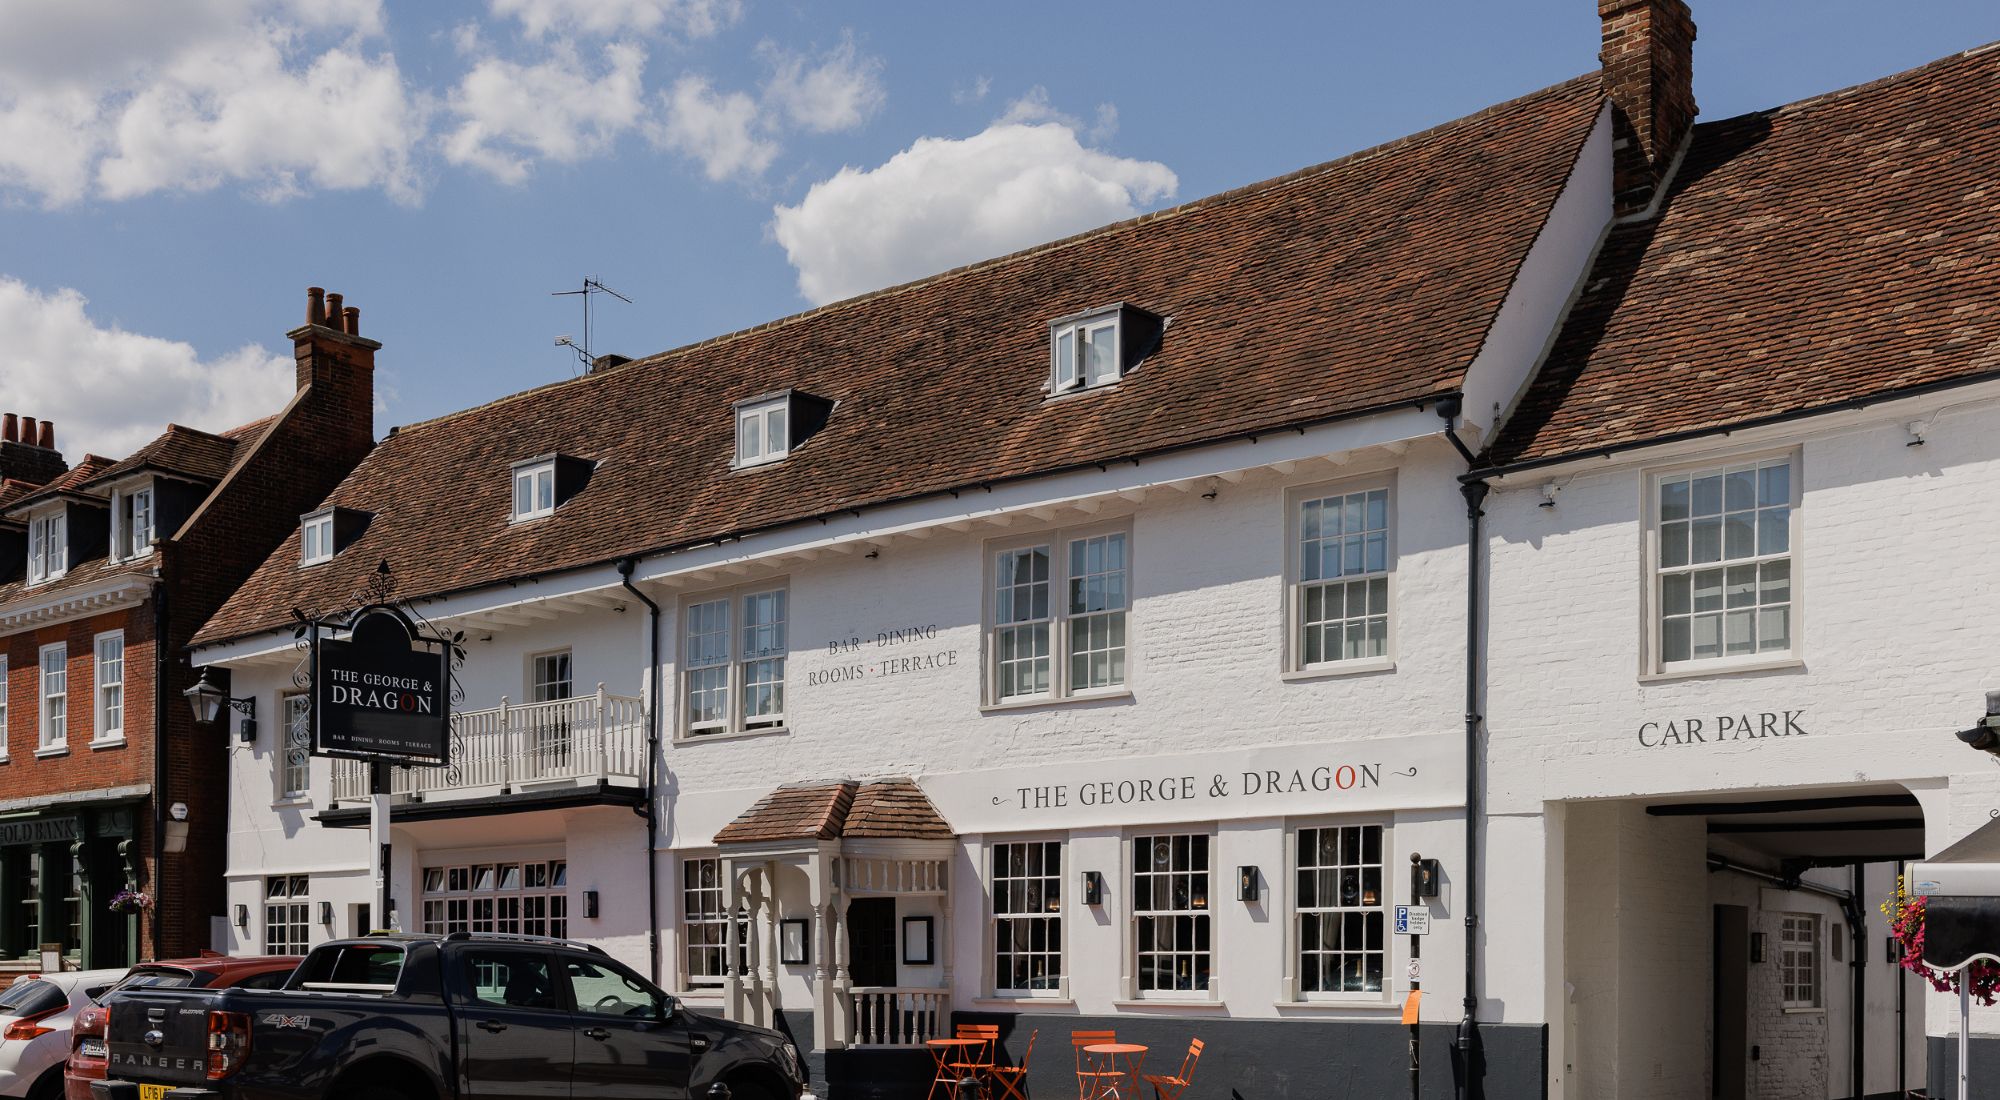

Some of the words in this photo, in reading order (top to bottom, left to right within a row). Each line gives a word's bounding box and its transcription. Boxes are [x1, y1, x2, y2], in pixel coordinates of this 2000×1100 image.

[829, 637, 860, 655] BAR
[877, 624, 937, 648] DINING
[331, 669, 359, 683] THE
[363, 673, 419, 690] GEORGE
[423, 681, 433, 692] &
[808, 664, 864, 687] ROOMS
[880, 650, 958, 675] TERRACE
[331, 685, 432, 714] DRAGON
[1638, 718, 1708, 748] CAR
[1715, 709, 1809, 742] PARK
[405, 741, 432, 749] TERRACE
[1016, 785, 1068, 809] THE
[1079, 776, 1196, 806] GEORGE
[1208, 774, 1229, 798] &
[1241, 763, 1382, 796] DRAGON
[4, 823, 33, 844] OLD
[35, 819, 75, 841] BANK
[1398, 908, 1406, 918] P
[112, 1053, 204, 1071] RANGER
